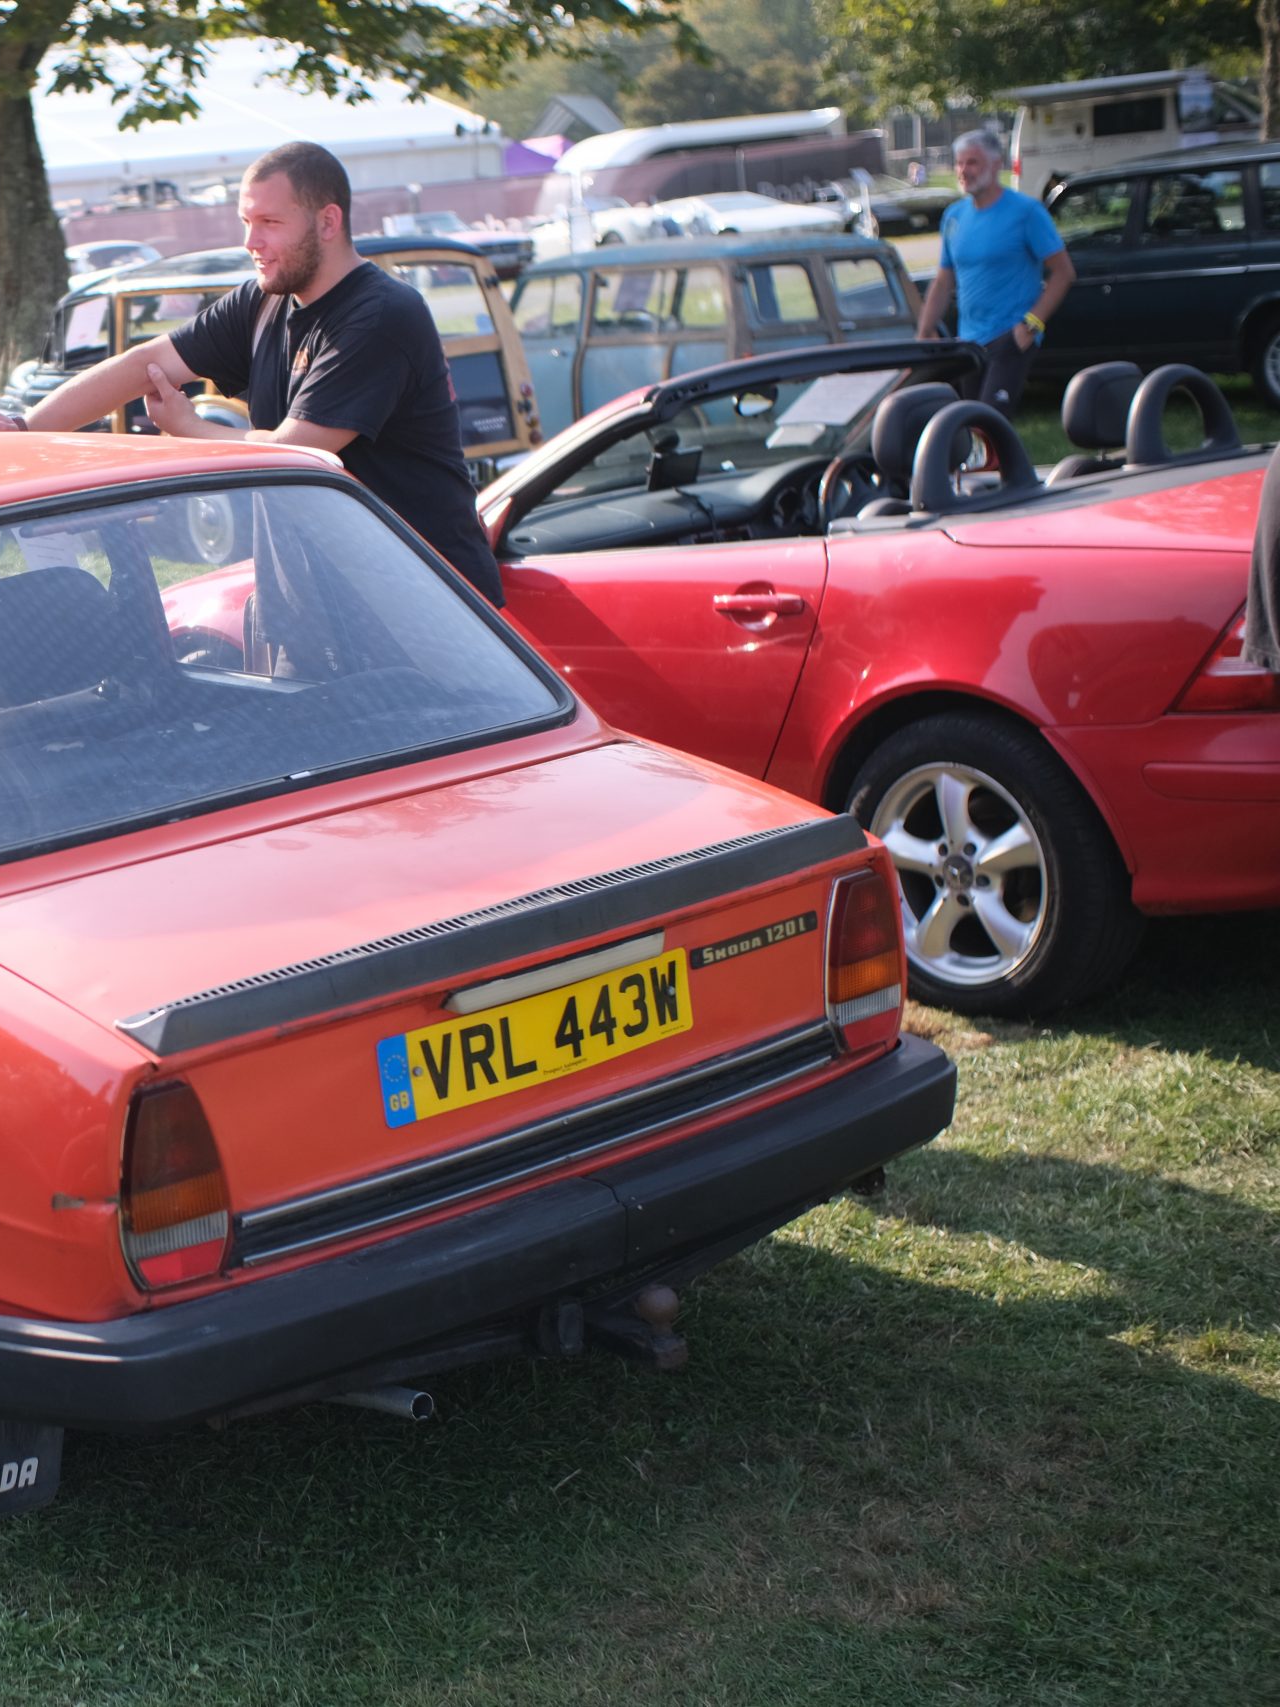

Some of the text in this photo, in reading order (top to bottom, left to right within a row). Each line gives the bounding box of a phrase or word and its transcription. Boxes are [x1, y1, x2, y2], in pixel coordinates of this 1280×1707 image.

[419, 960, 679, 1101] VRL 443W
[389, 1090, 410, 1112] GB
